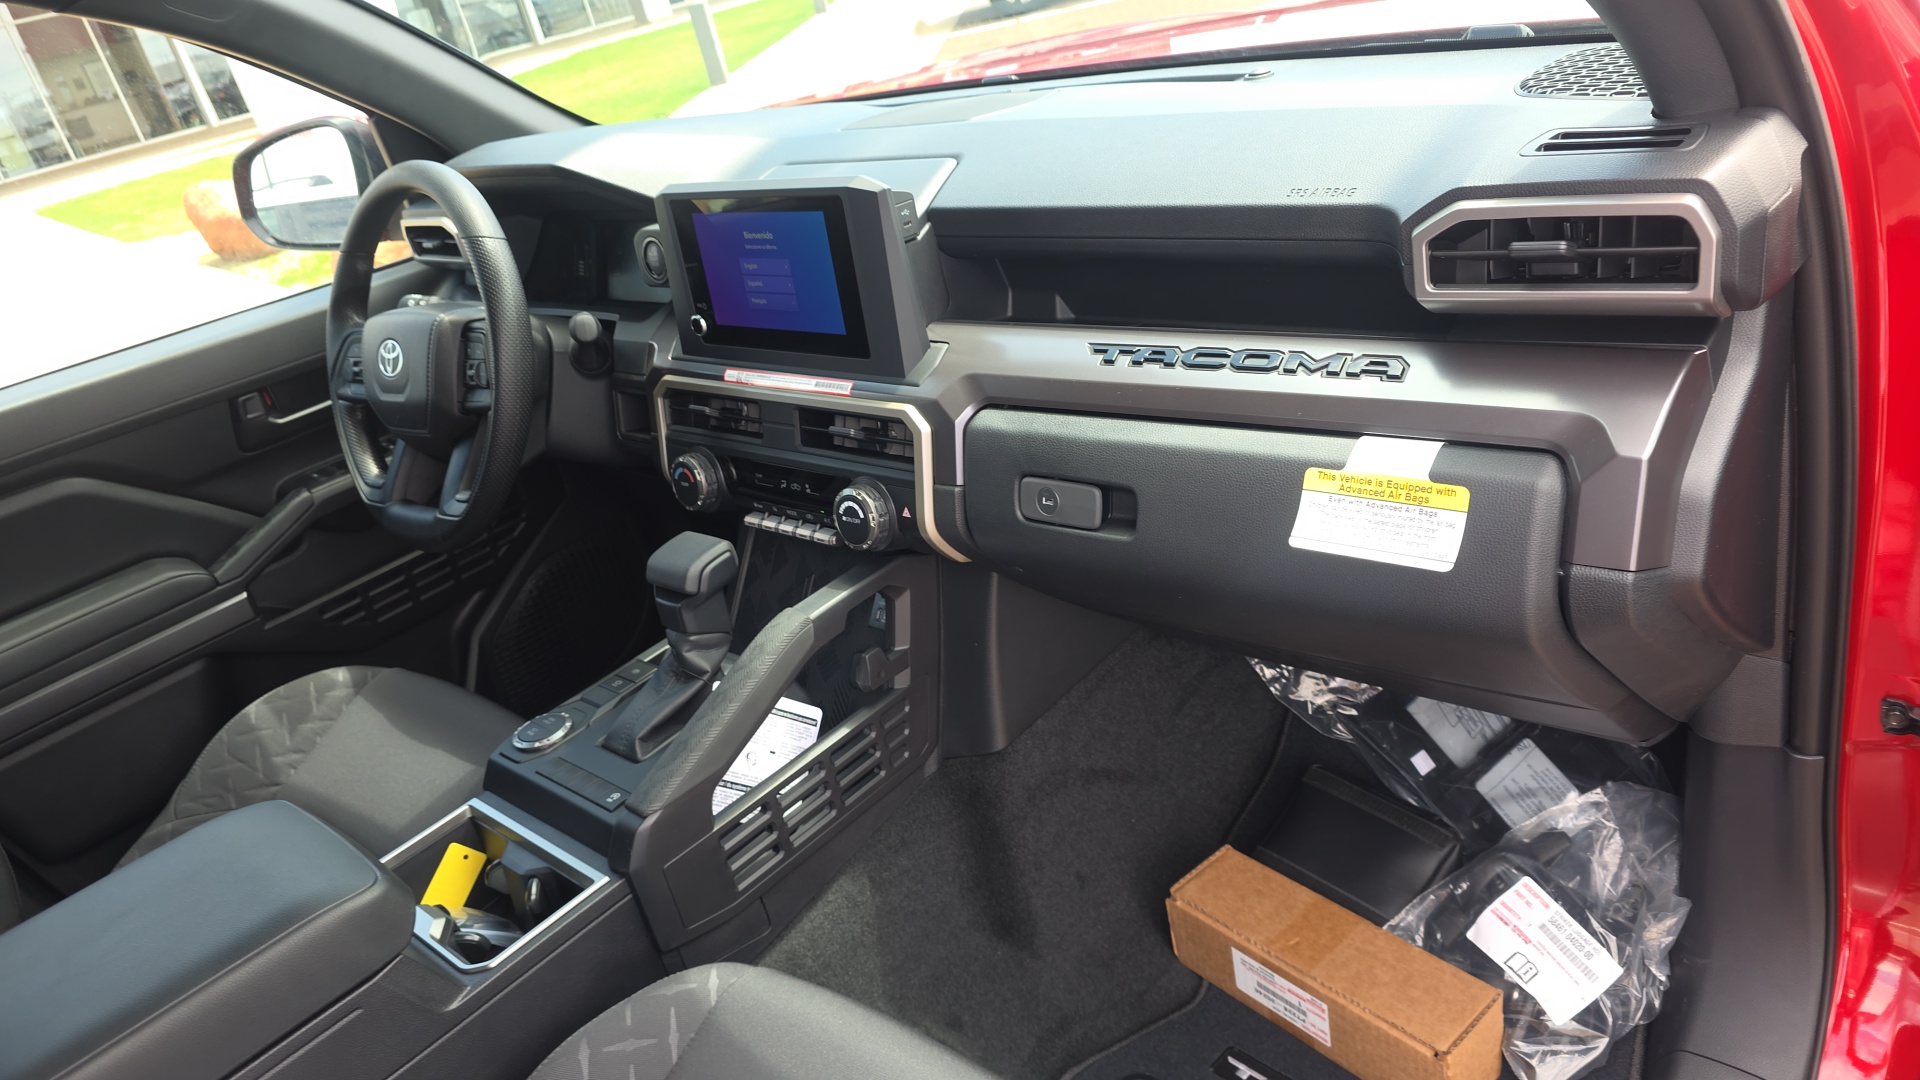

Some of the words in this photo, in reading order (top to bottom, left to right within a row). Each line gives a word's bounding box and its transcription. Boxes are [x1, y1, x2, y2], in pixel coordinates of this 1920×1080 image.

[1286, 188, 1309, 198] SRS
[1309, 187, 1358, 198] AIRBAG
[743, 231, 774, 240] Bienvenido
[1088, 342, 1410, 383] TACOMA
[1317, 470, 1337, 481] This
[1339, 473, 1373, 486] Vehicle
[1375, 478, 1384, 488] is
[1386, 479, 1433, 494] Equipped
[1435, 486, 1457, 498] with
[1339, 483, 1386, 498] Advanced
[1387, 490, 1403, 500] Air
[1404, 492, 1430, 505] Bags
[1328, 495, 1346, 504] Even
[1365, 500, 1403, 513] Advanced
[1404, 506, 1416, 514] Air
[1418, 507, 1438, 519] Bags
